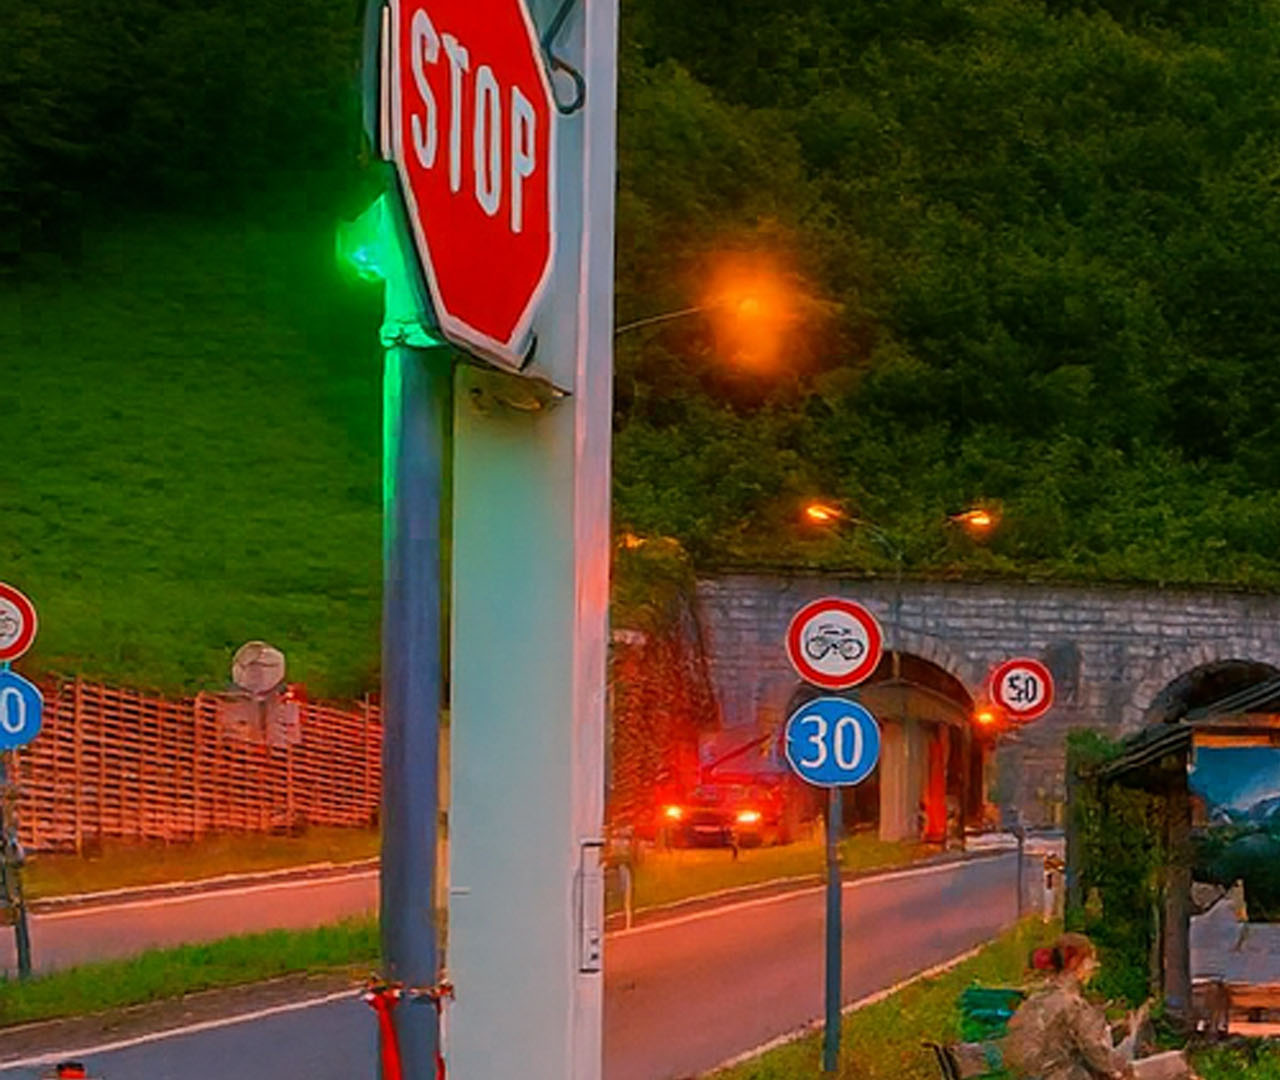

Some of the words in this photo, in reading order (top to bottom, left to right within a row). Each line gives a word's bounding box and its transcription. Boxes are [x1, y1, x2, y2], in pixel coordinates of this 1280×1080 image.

[411, 8, 536, 234] STOP
[1007, 675, 1038, 704] 50
[800, 715, 864, 771] 30
